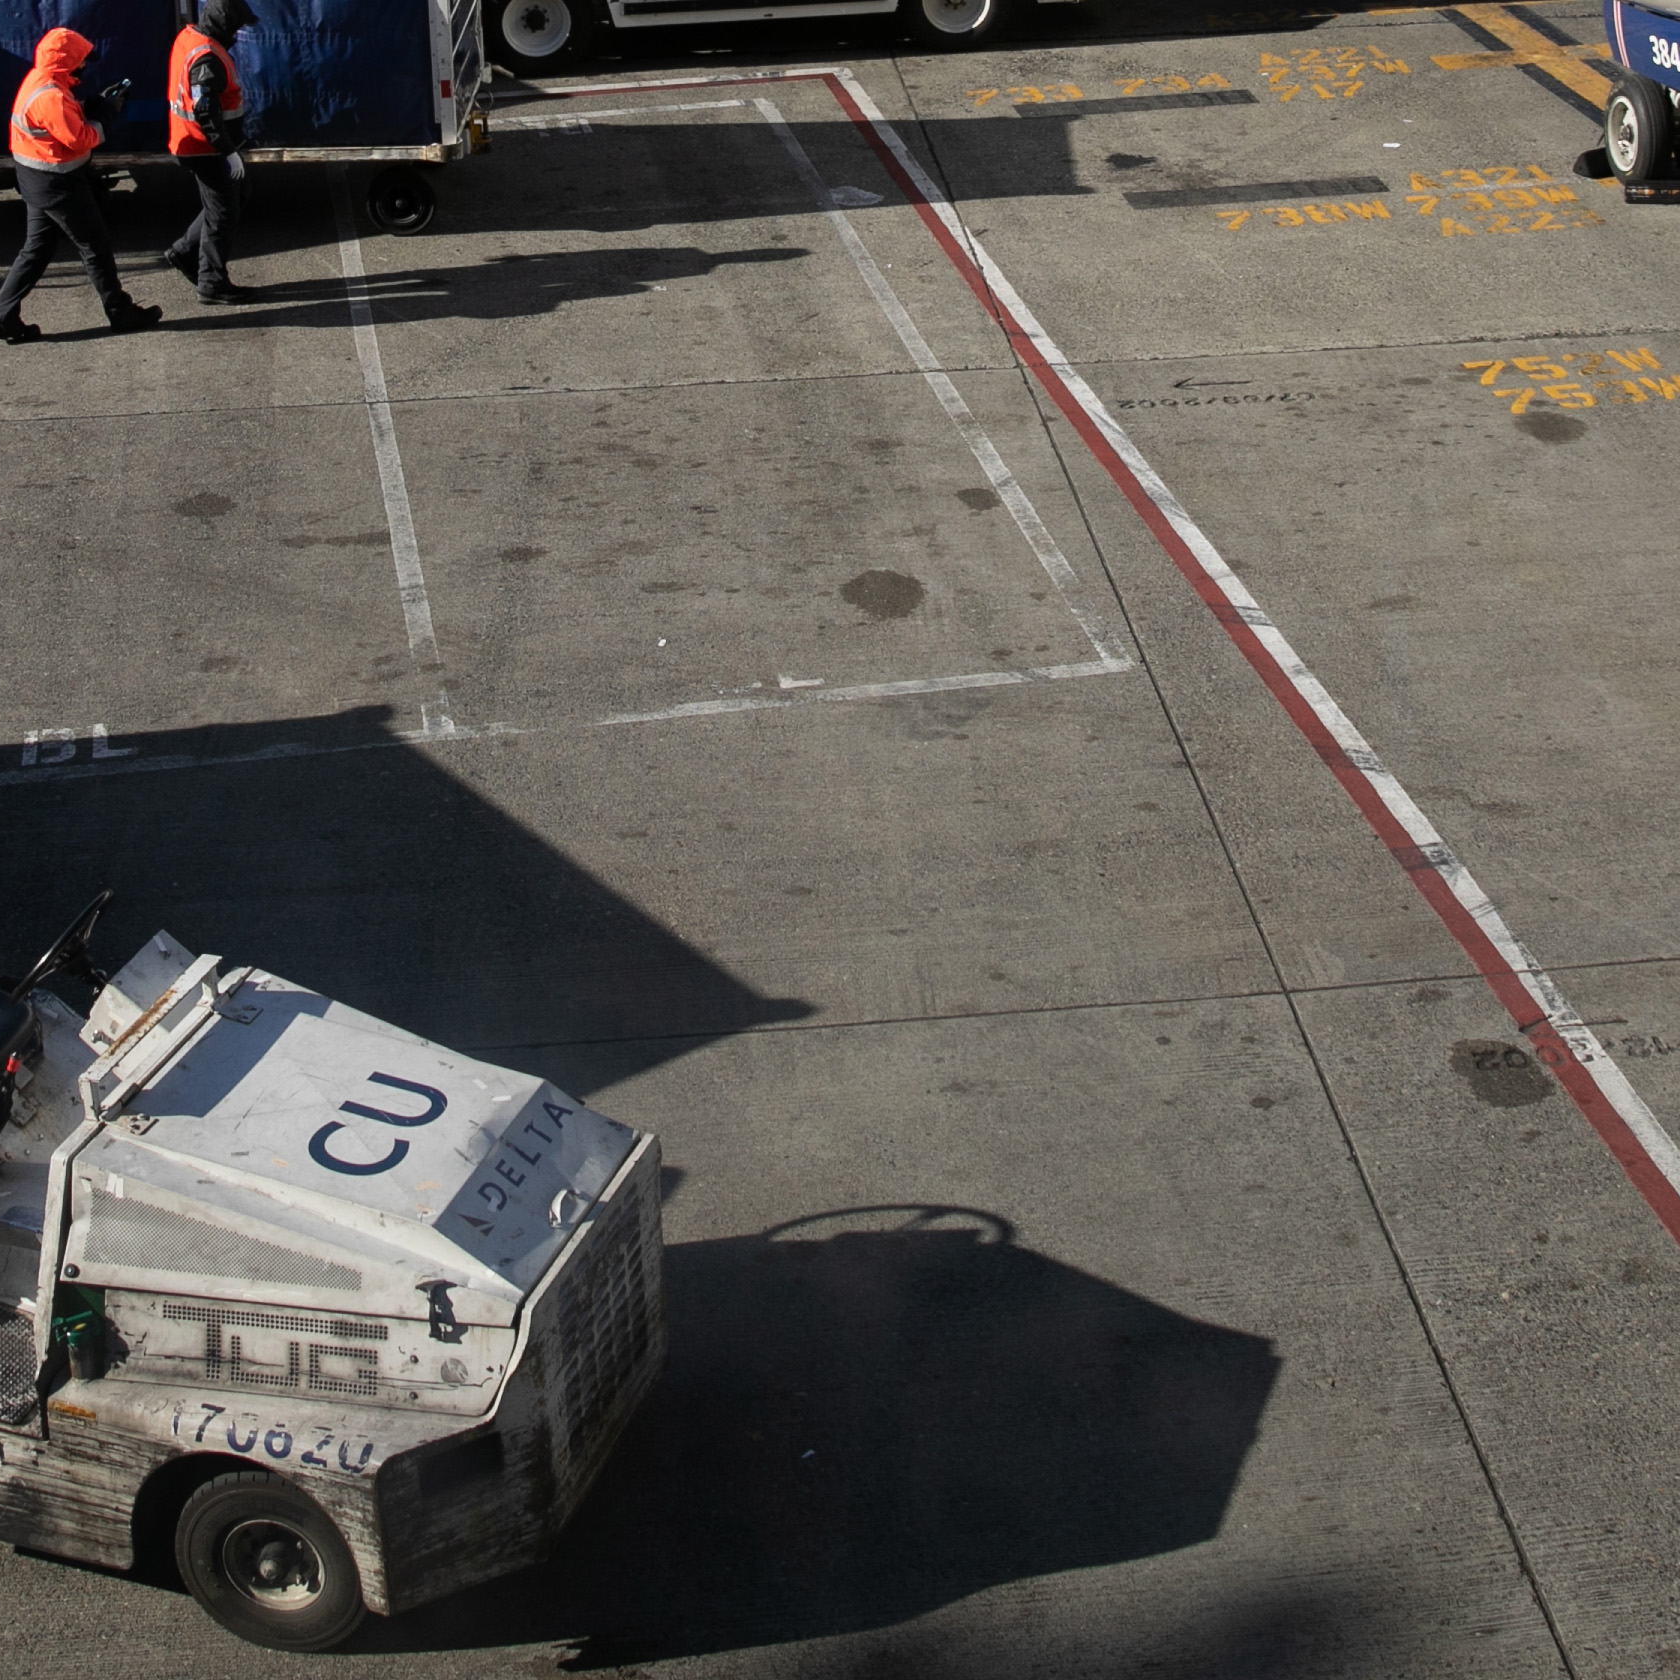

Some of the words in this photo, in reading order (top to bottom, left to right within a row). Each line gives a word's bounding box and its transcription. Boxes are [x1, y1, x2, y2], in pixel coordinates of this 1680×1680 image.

[19, 722, 141, 767] BL
[308, 1070, 449, 1177] CU
[477, 1100, 576, 1212] DELTA
[162, 1303, 390, 1397] TUG
